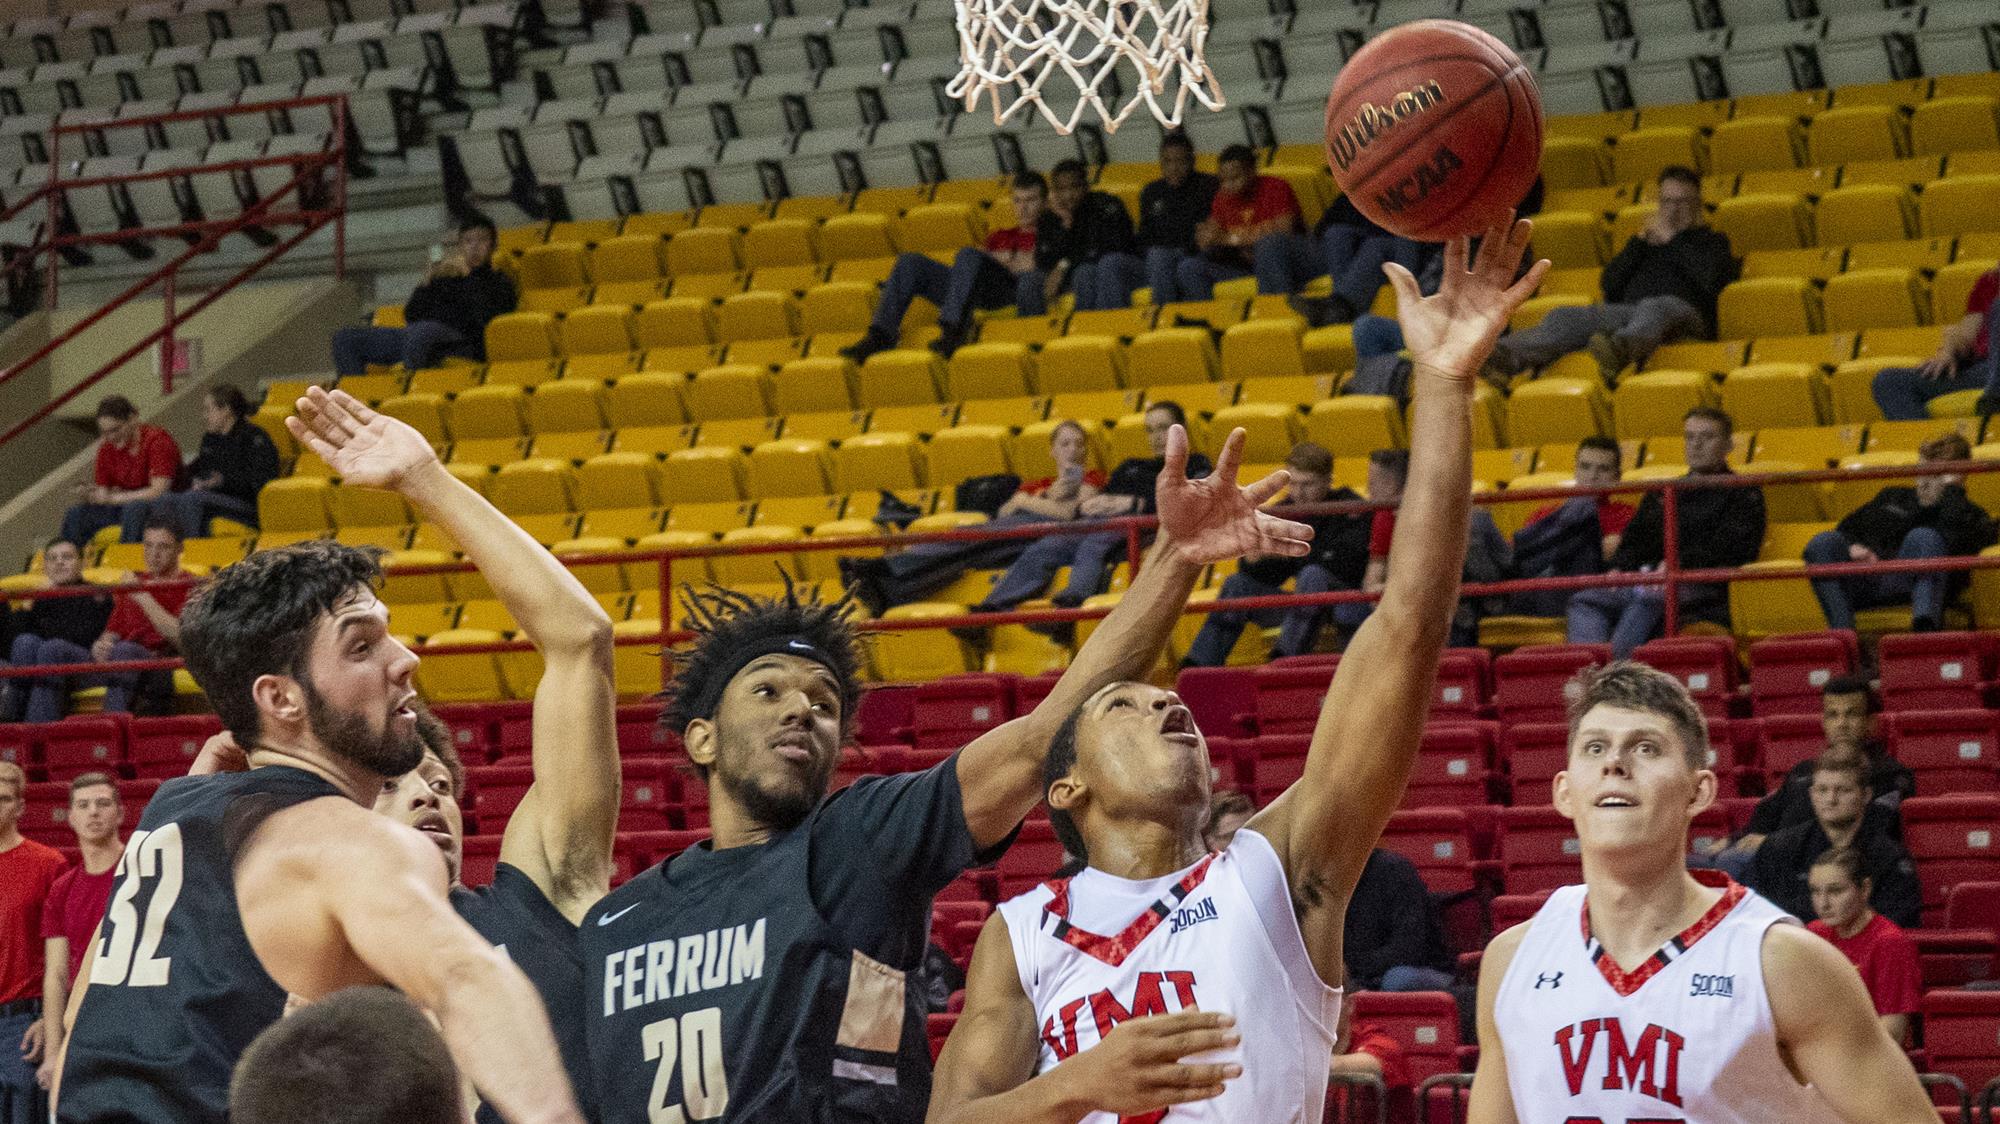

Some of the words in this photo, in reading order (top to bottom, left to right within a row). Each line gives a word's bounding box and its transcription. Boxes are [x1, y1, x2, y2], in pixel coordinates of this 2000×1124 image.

[1331, 80, 1444, 172] Wilson
[1375, 145, 1462, 213] NCAA
[88, 822, 183, 987] 32
[604, 917, 766, 1017] FERRUM
[1690, 973, 1735, 998] SOCON
[641, 1006, 729, 1124] 20
[1554, 1016, 1685, 1109] VMI
